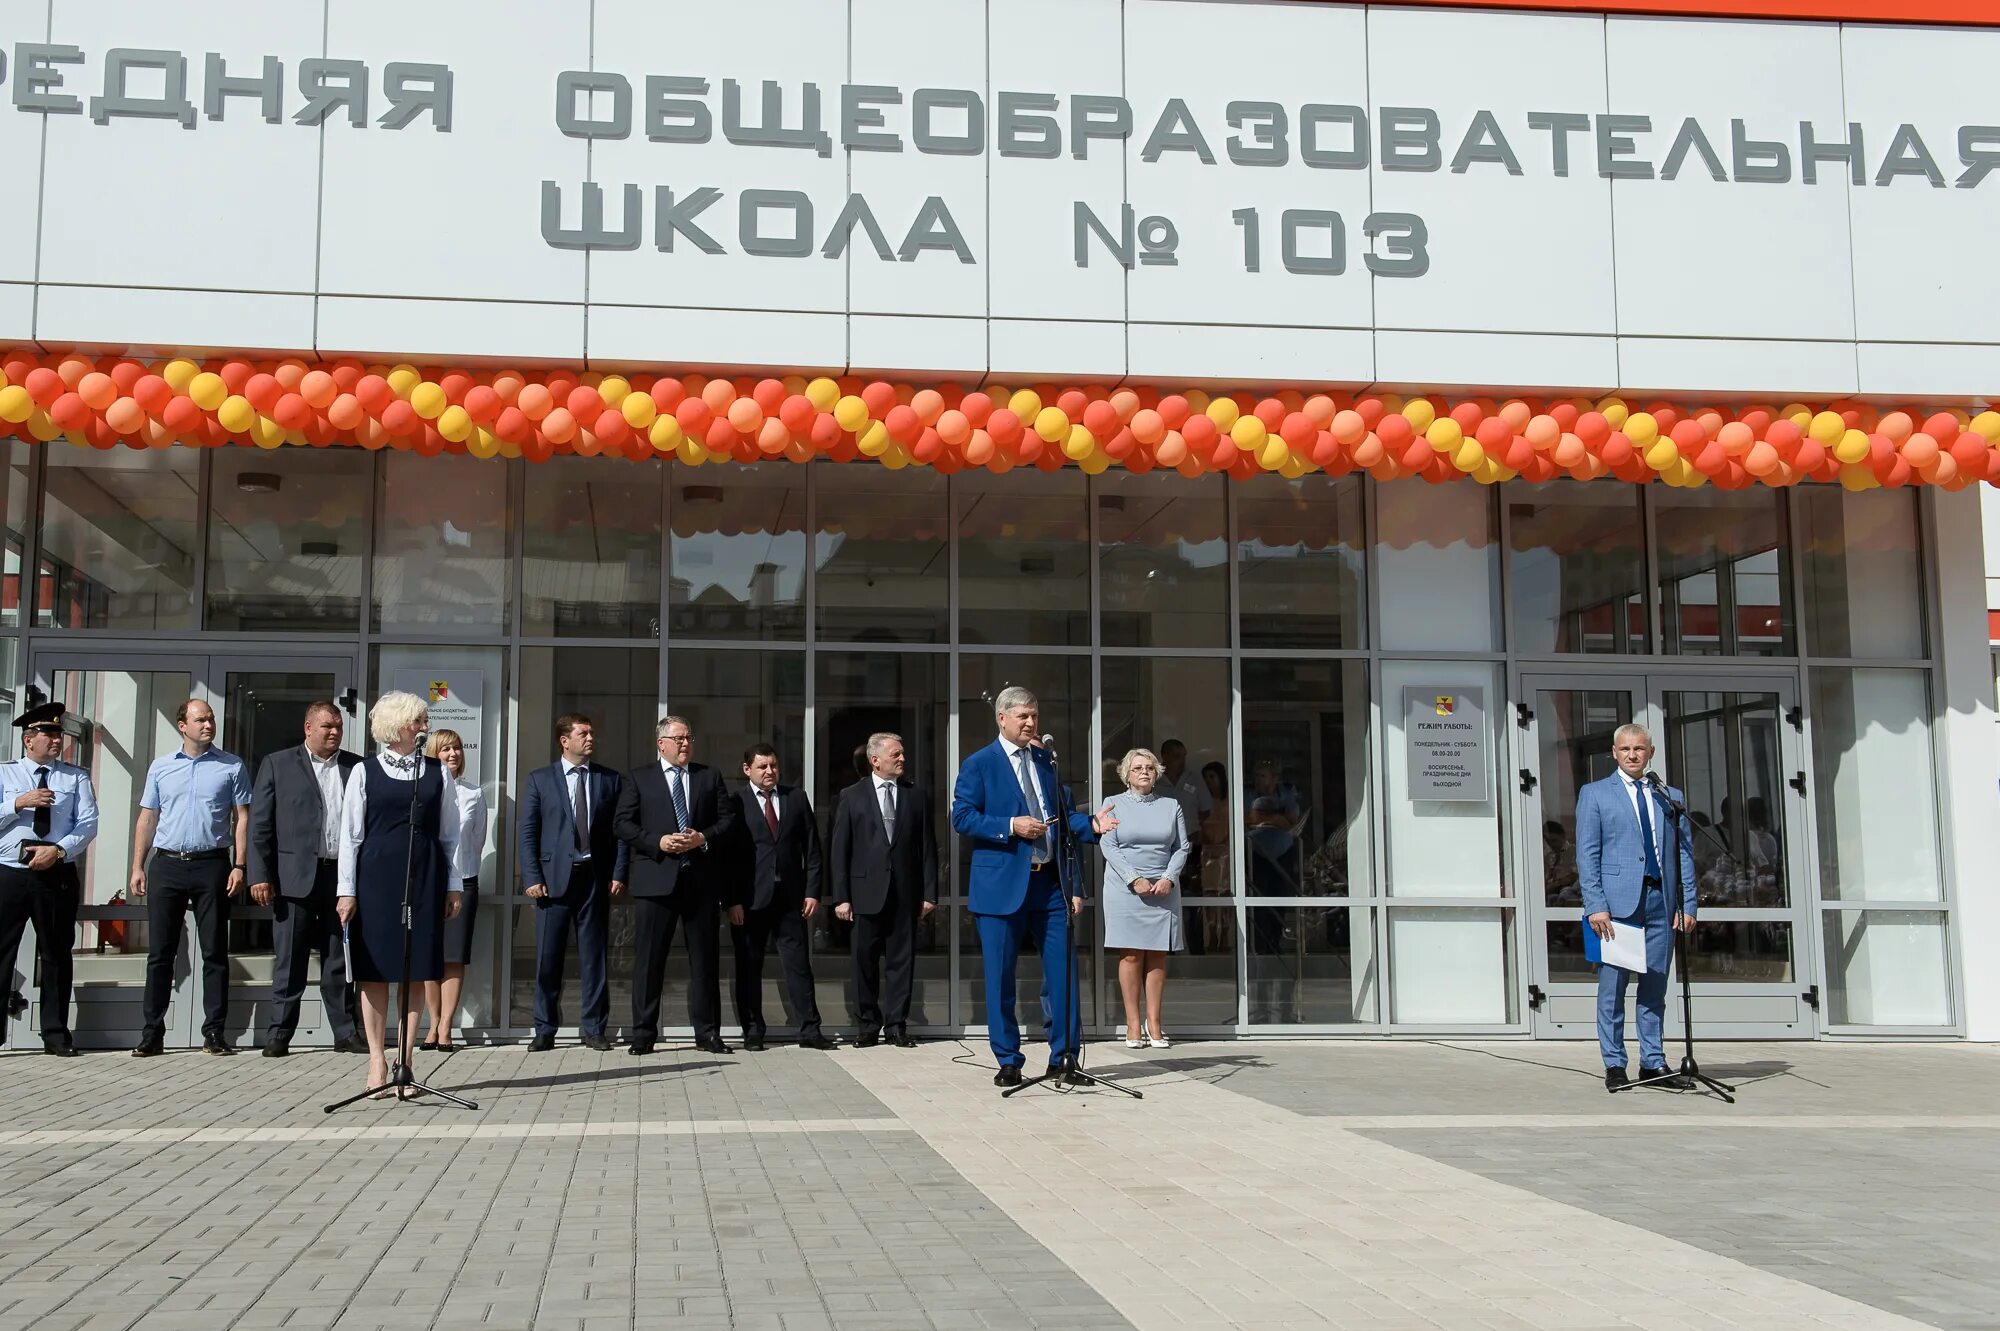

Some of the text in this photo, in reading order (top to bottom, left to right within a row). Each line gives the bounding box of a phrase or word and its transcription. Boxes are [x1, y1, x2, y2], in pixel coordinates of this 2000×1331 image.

[0, 42, 453, 132] ЕДНЯЯ
[541, 181, 1430, 278] ШКОЛА № 103
